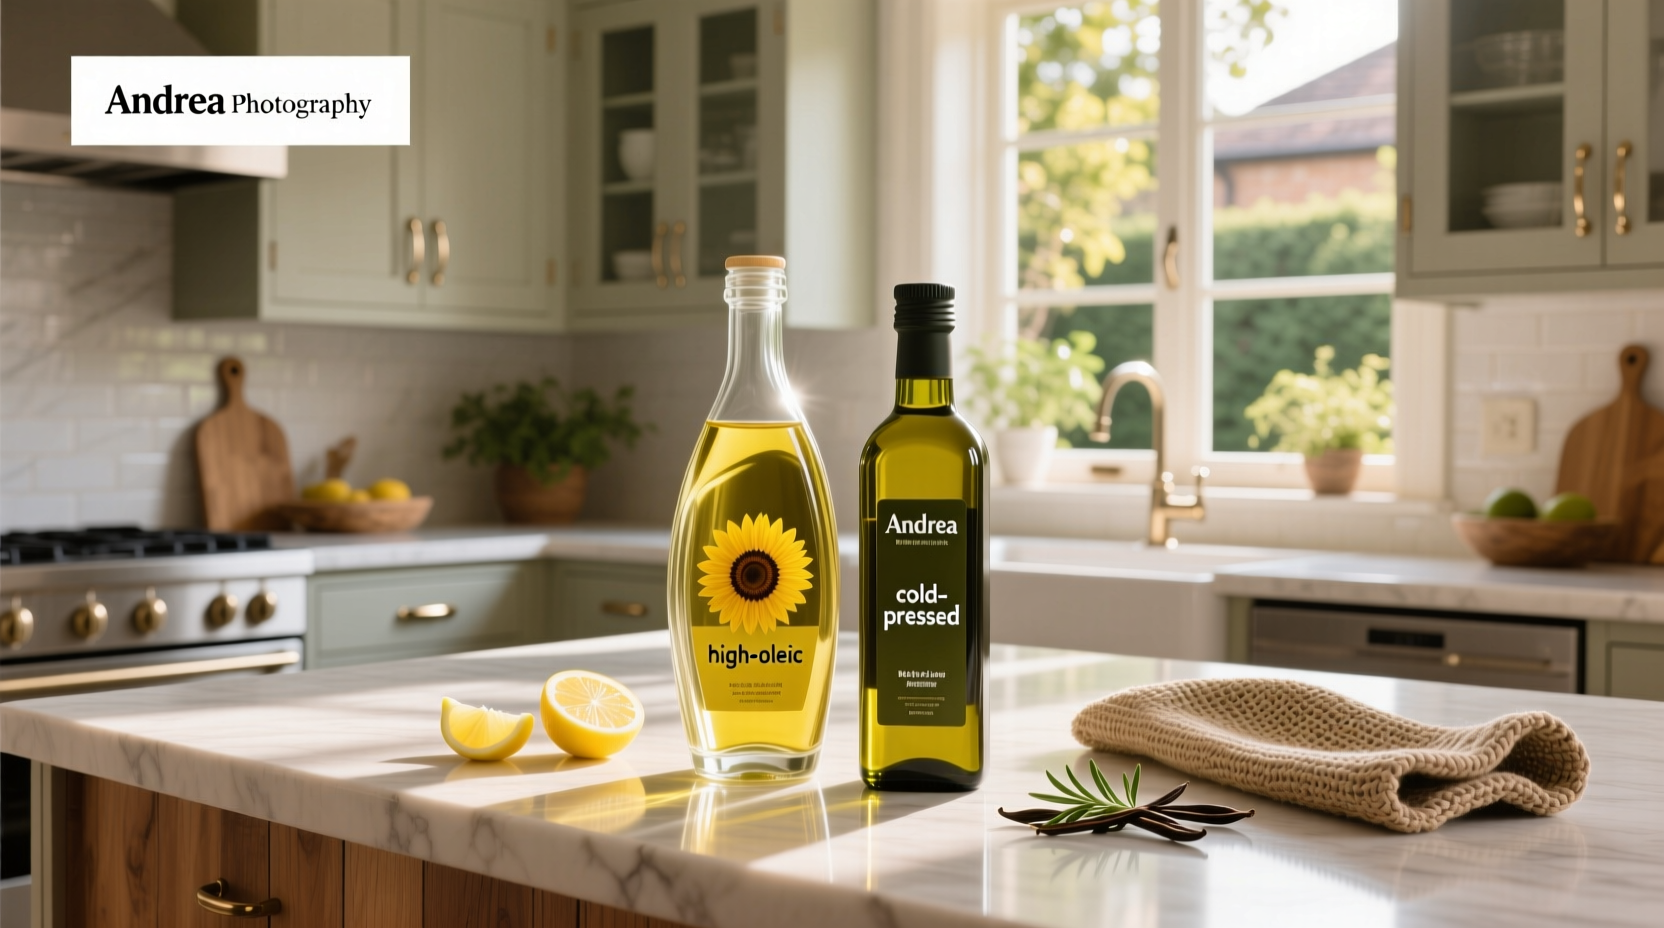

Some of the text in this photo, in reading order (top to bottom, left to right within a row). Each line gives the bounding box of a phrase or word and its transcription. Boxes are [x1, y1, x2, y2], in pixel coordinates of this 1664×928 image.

[884, 512, 958, 535] Andrea
[895, 582, 948, 604] cold-
[883, 604, 960, 631] pressed
[708, 643, 803, 670] high-oleic
